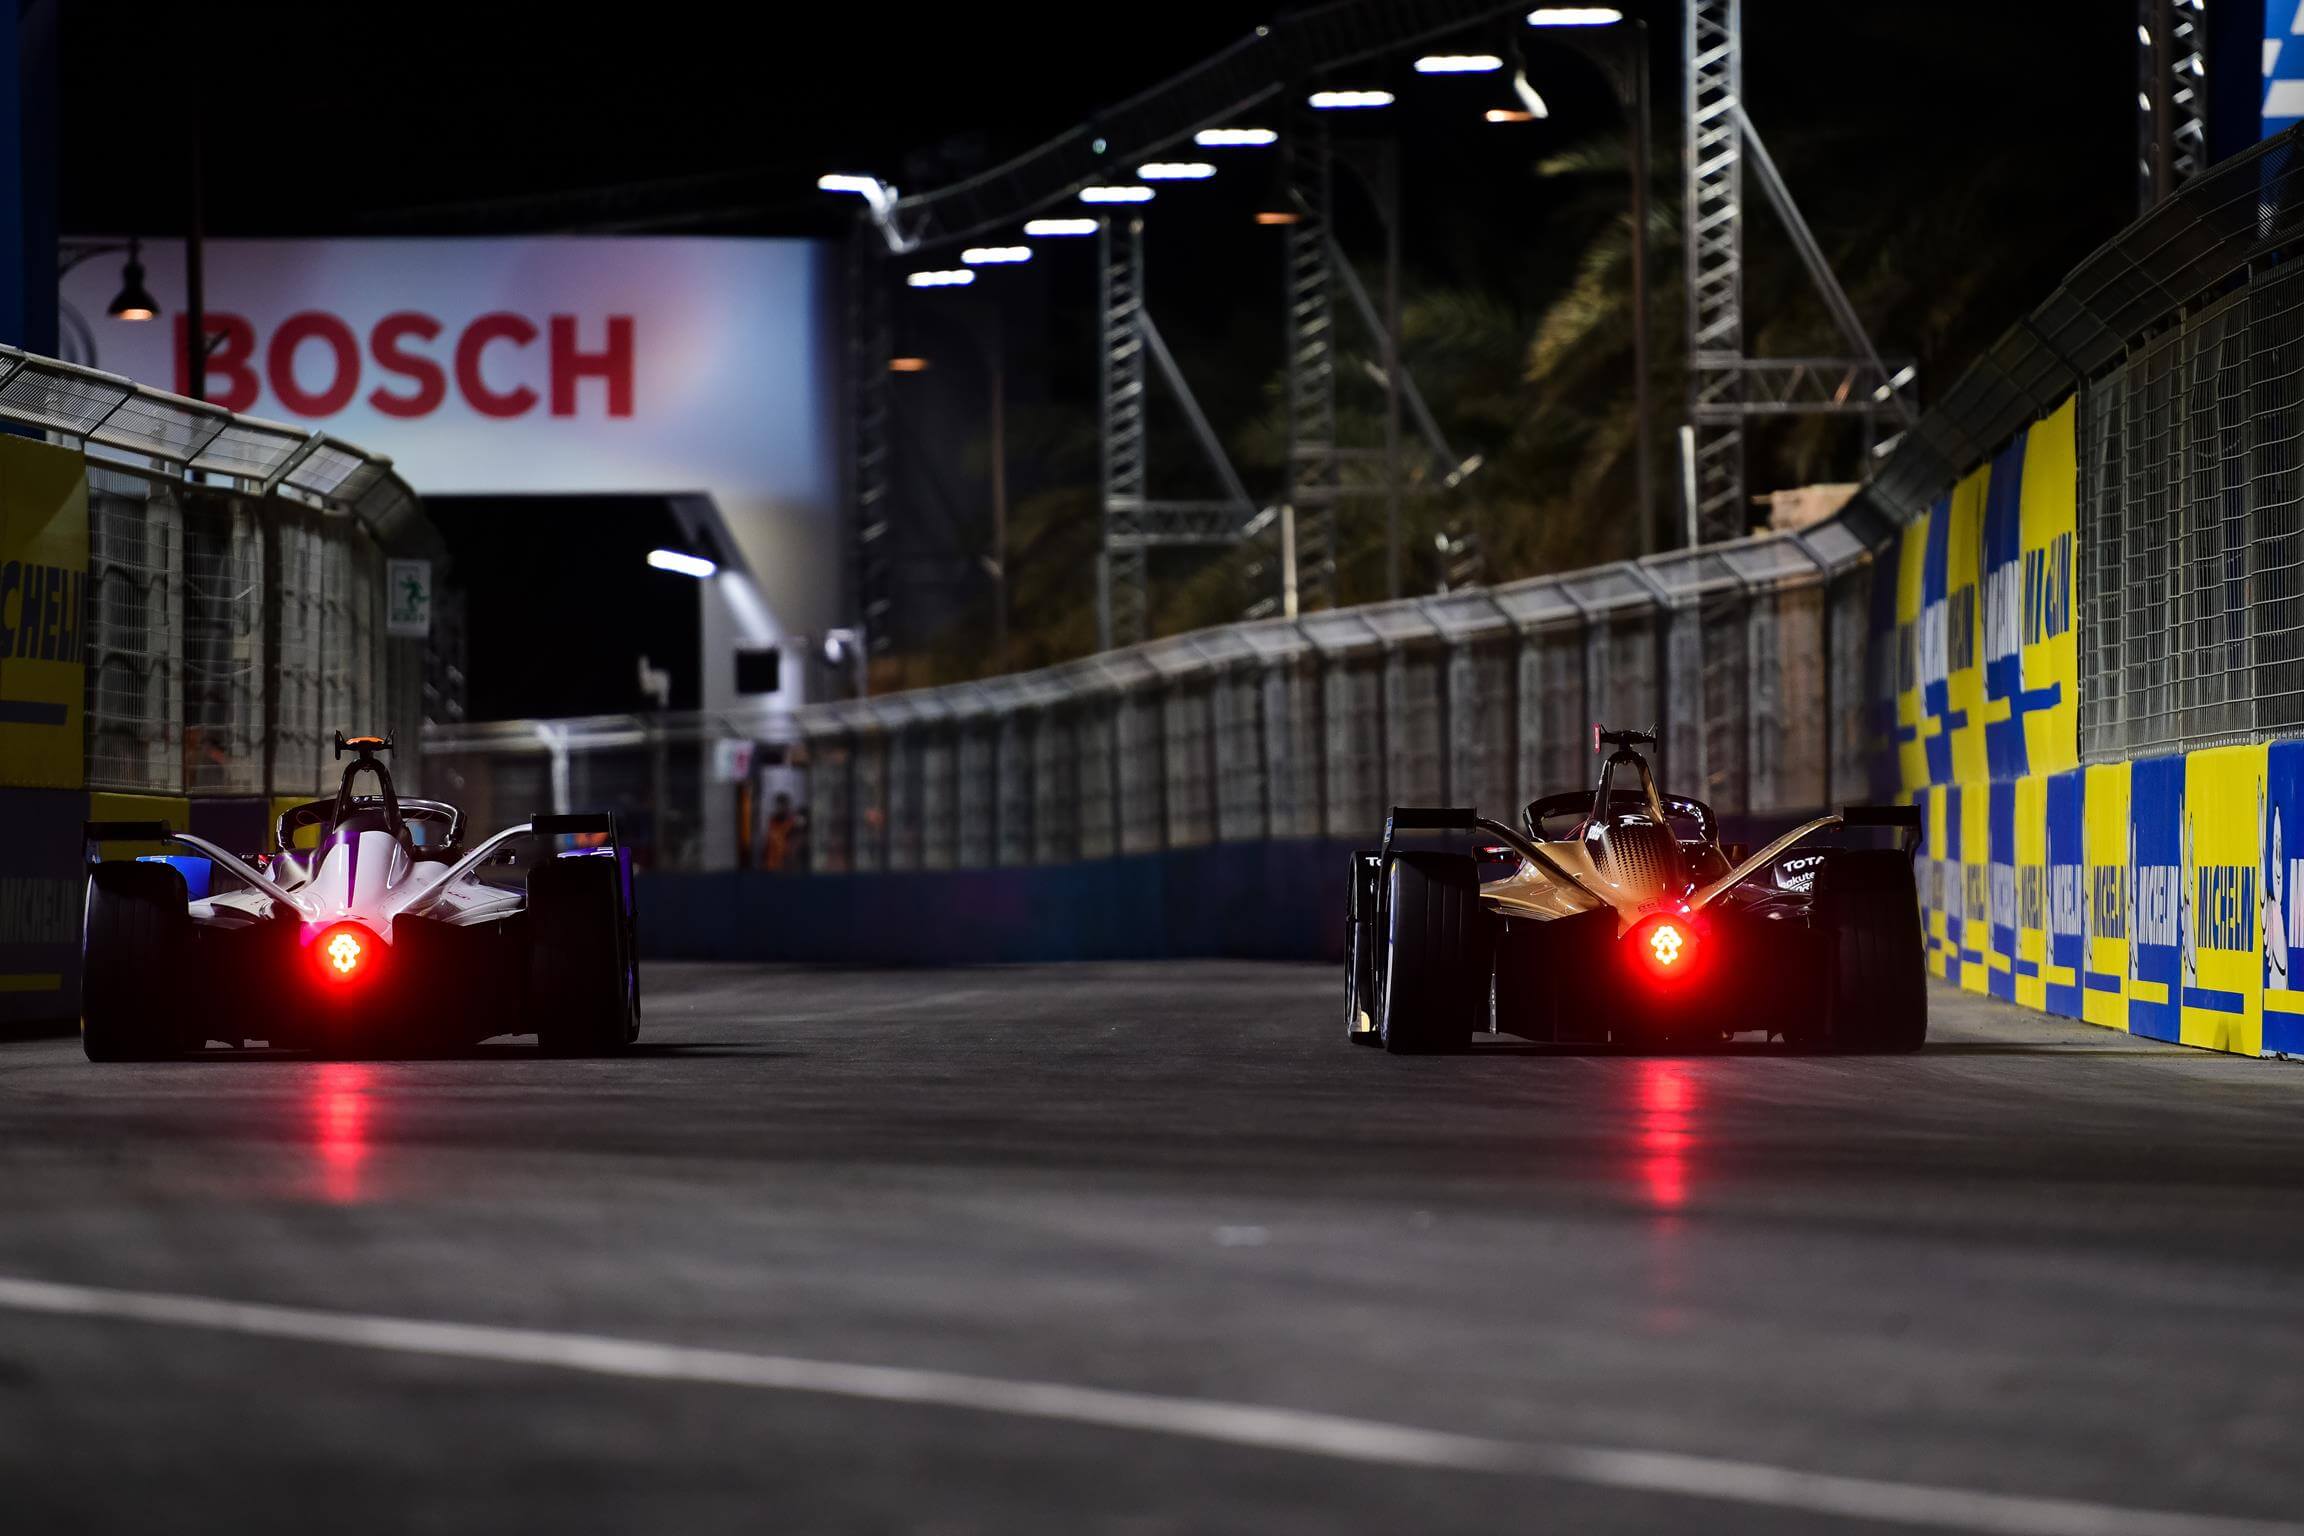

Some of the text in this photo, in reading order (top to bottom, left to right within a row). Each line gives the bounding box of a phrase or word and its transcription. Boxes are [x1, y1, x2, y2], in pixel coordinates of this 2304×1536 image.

[173, 309, 635, 418] BOSCH
[2093, 865, 2126, 940] MICHELIN
[2138, 865, 2179, 947] MICHELIN
[2197, 864, 2256, 953] MICHELIN
